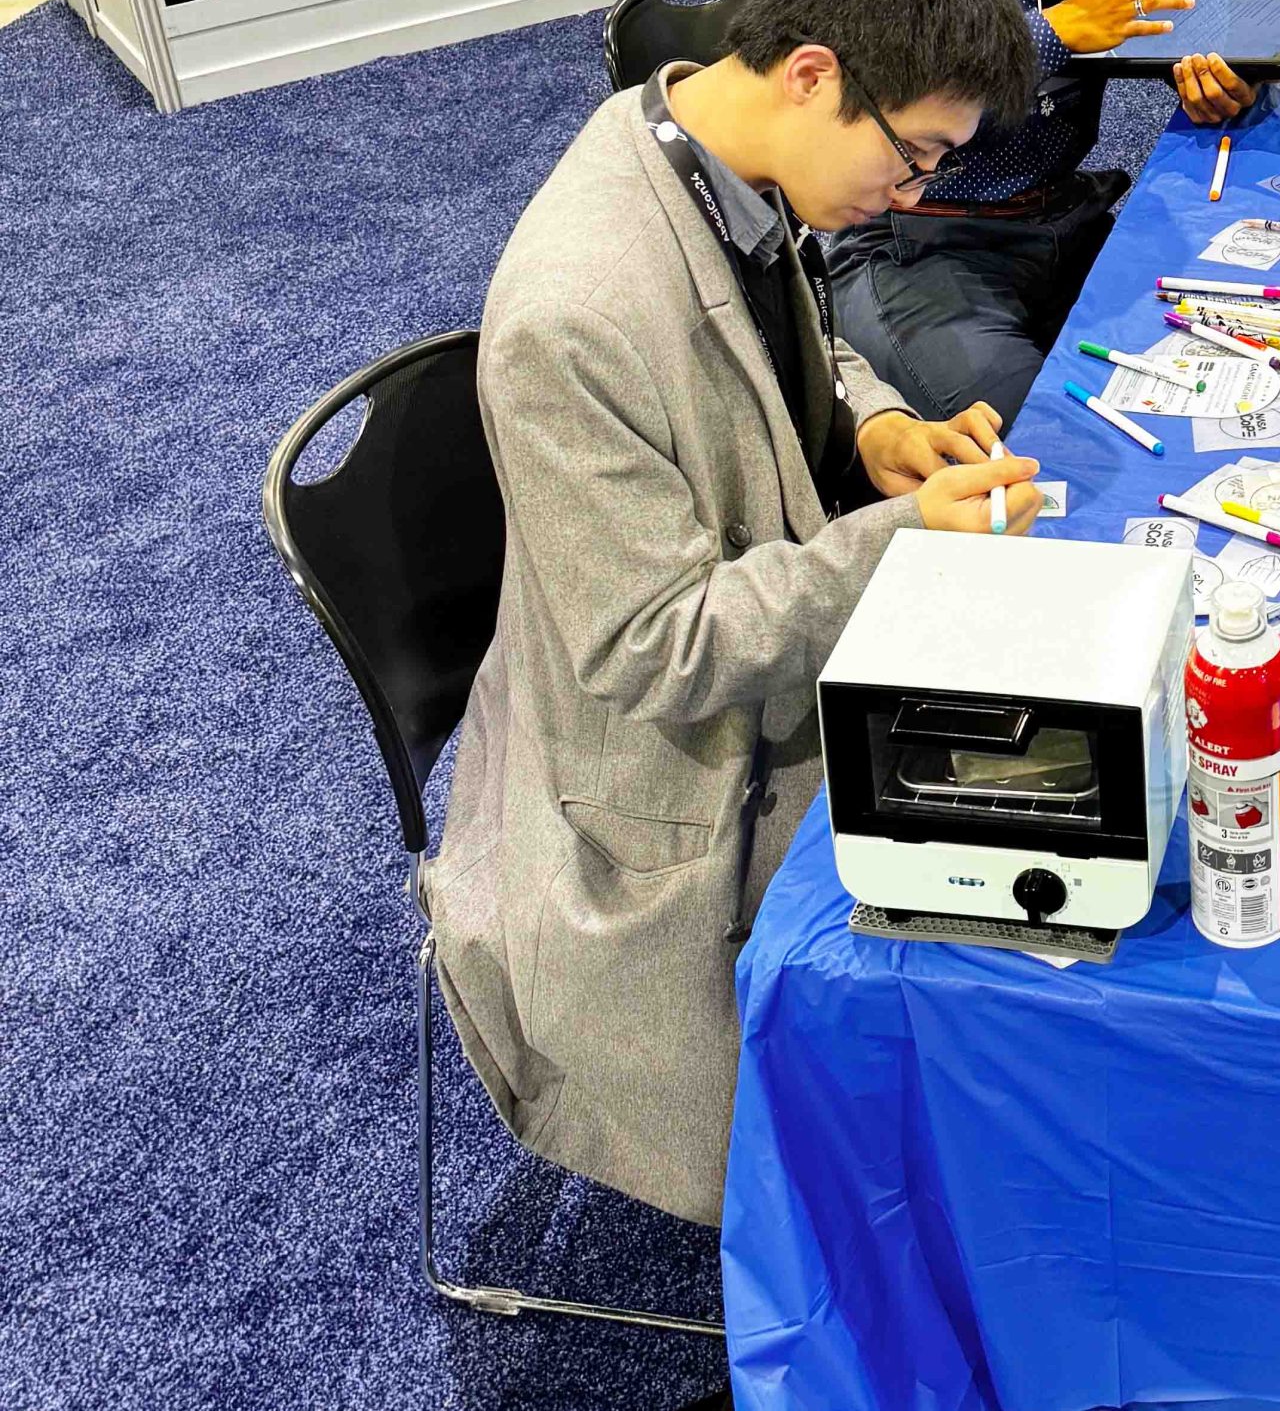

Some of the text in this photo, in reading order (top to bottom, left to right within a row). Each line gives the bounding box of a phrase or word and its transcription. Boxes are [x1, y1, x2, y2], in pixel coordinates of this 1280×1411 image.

[1254, 412, 1267, 431] NASA
[1144, 523, 1163, 547] SCo
[1162, 530, 1173, 547] NAS
[1213, 677, 1227, 687] FIRE
[1195, 736, 1230, 756] ALERT
[1199, 756, 1238, 776] SPRAY
[1222, 829, 1227, 838] 3
